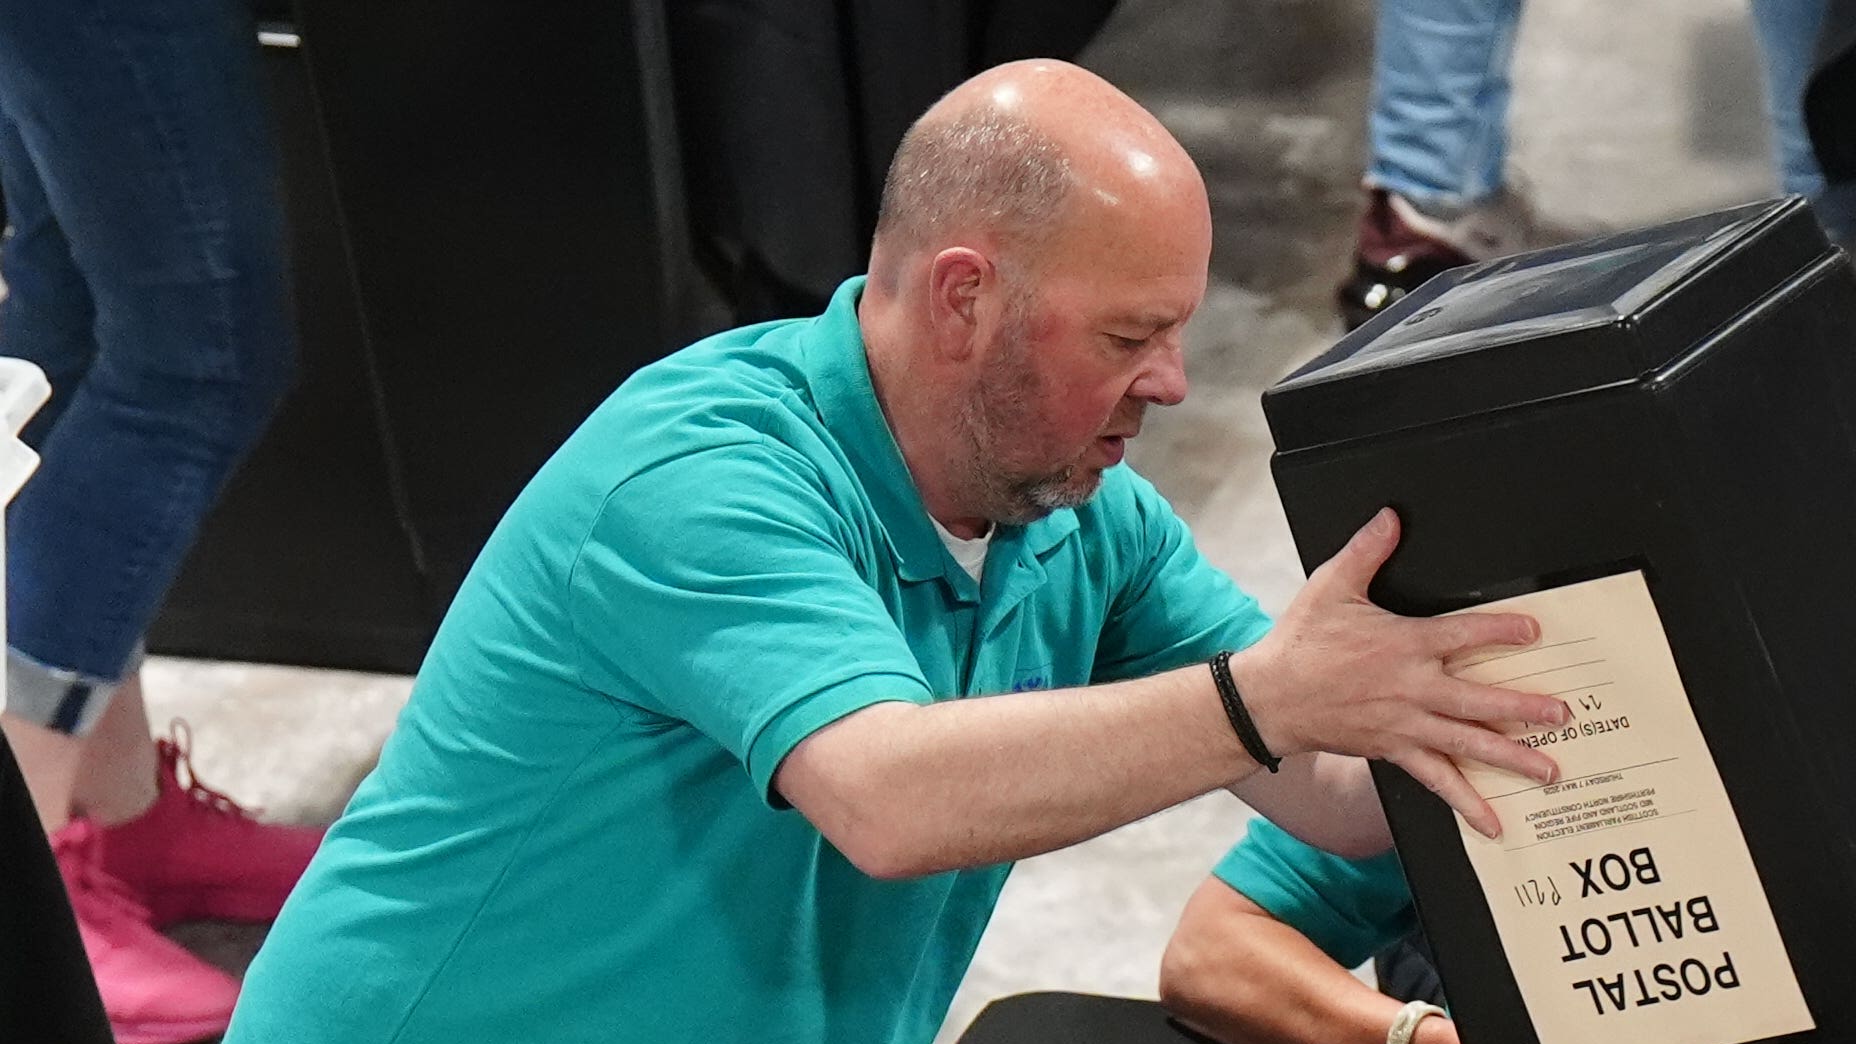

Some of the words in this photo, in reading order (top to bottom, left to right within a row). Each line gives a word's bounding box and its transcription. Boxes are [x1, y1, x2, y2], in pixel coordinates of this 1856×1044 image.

[1580, 715, 1629, 736] DATE(S)
[1515, 731, 1558, 749] OPEN
[1559, 727, 1578, 741] OF
[1561, 782, 1577, 791] MAY
[1585, 773, 1623, 786] THURSDAY
[1610, 788, 1655, 803] PERTHSHIRE
[1583, 797, 1609, 809] NORTH
[1599, 802, 1638, 816] SCOTLAND
[1524, 803, 1582, 821] CONSTITUENCY
[1565, 814, 1581, 823] FIFE
[1582, 810, 1598, 820] AND
[1622, 808, 1659, 821] SCOTTISH
[1534, 818, 1564, 830] REGION
[1575, 816, 1621, 832] PARLIAMENT
[1536, 826, 1574, 840] ELECTION
[1569, 847, 1660, 898] BOX
[1558, 896, 1719, 962] BALLOT
[1573, 952, 1740, 1016] POSTAL
